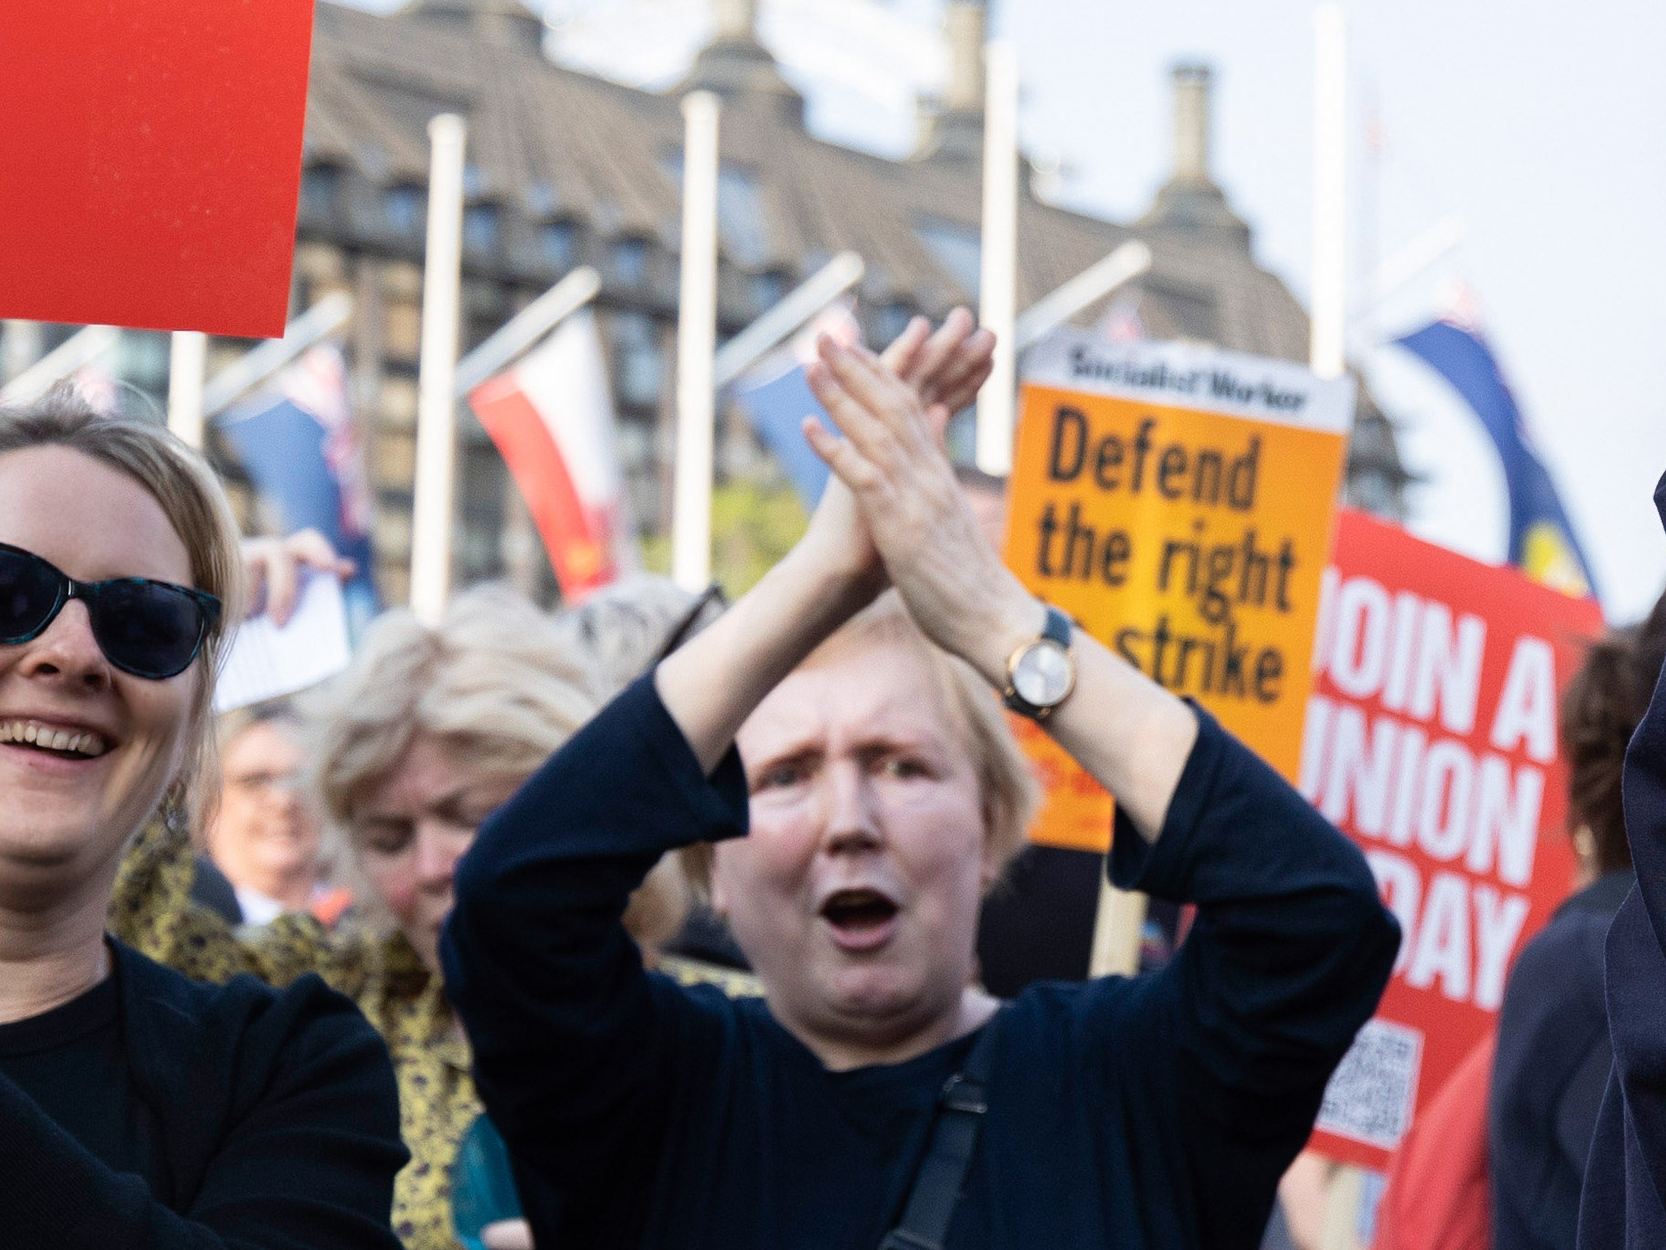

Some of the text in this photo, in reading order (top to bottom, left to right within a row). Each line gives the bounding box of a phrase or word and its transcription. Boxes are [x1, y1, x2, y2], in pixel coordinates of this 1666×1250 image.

[1071, 349, 1307, 413] Socialist Worker
[1048, 405, 1261, 512] Defend
[1036, 503, 1296, 626] the right
[1114, 612, 1284, 705] strike
[1490, 633, 1560, 767] A
